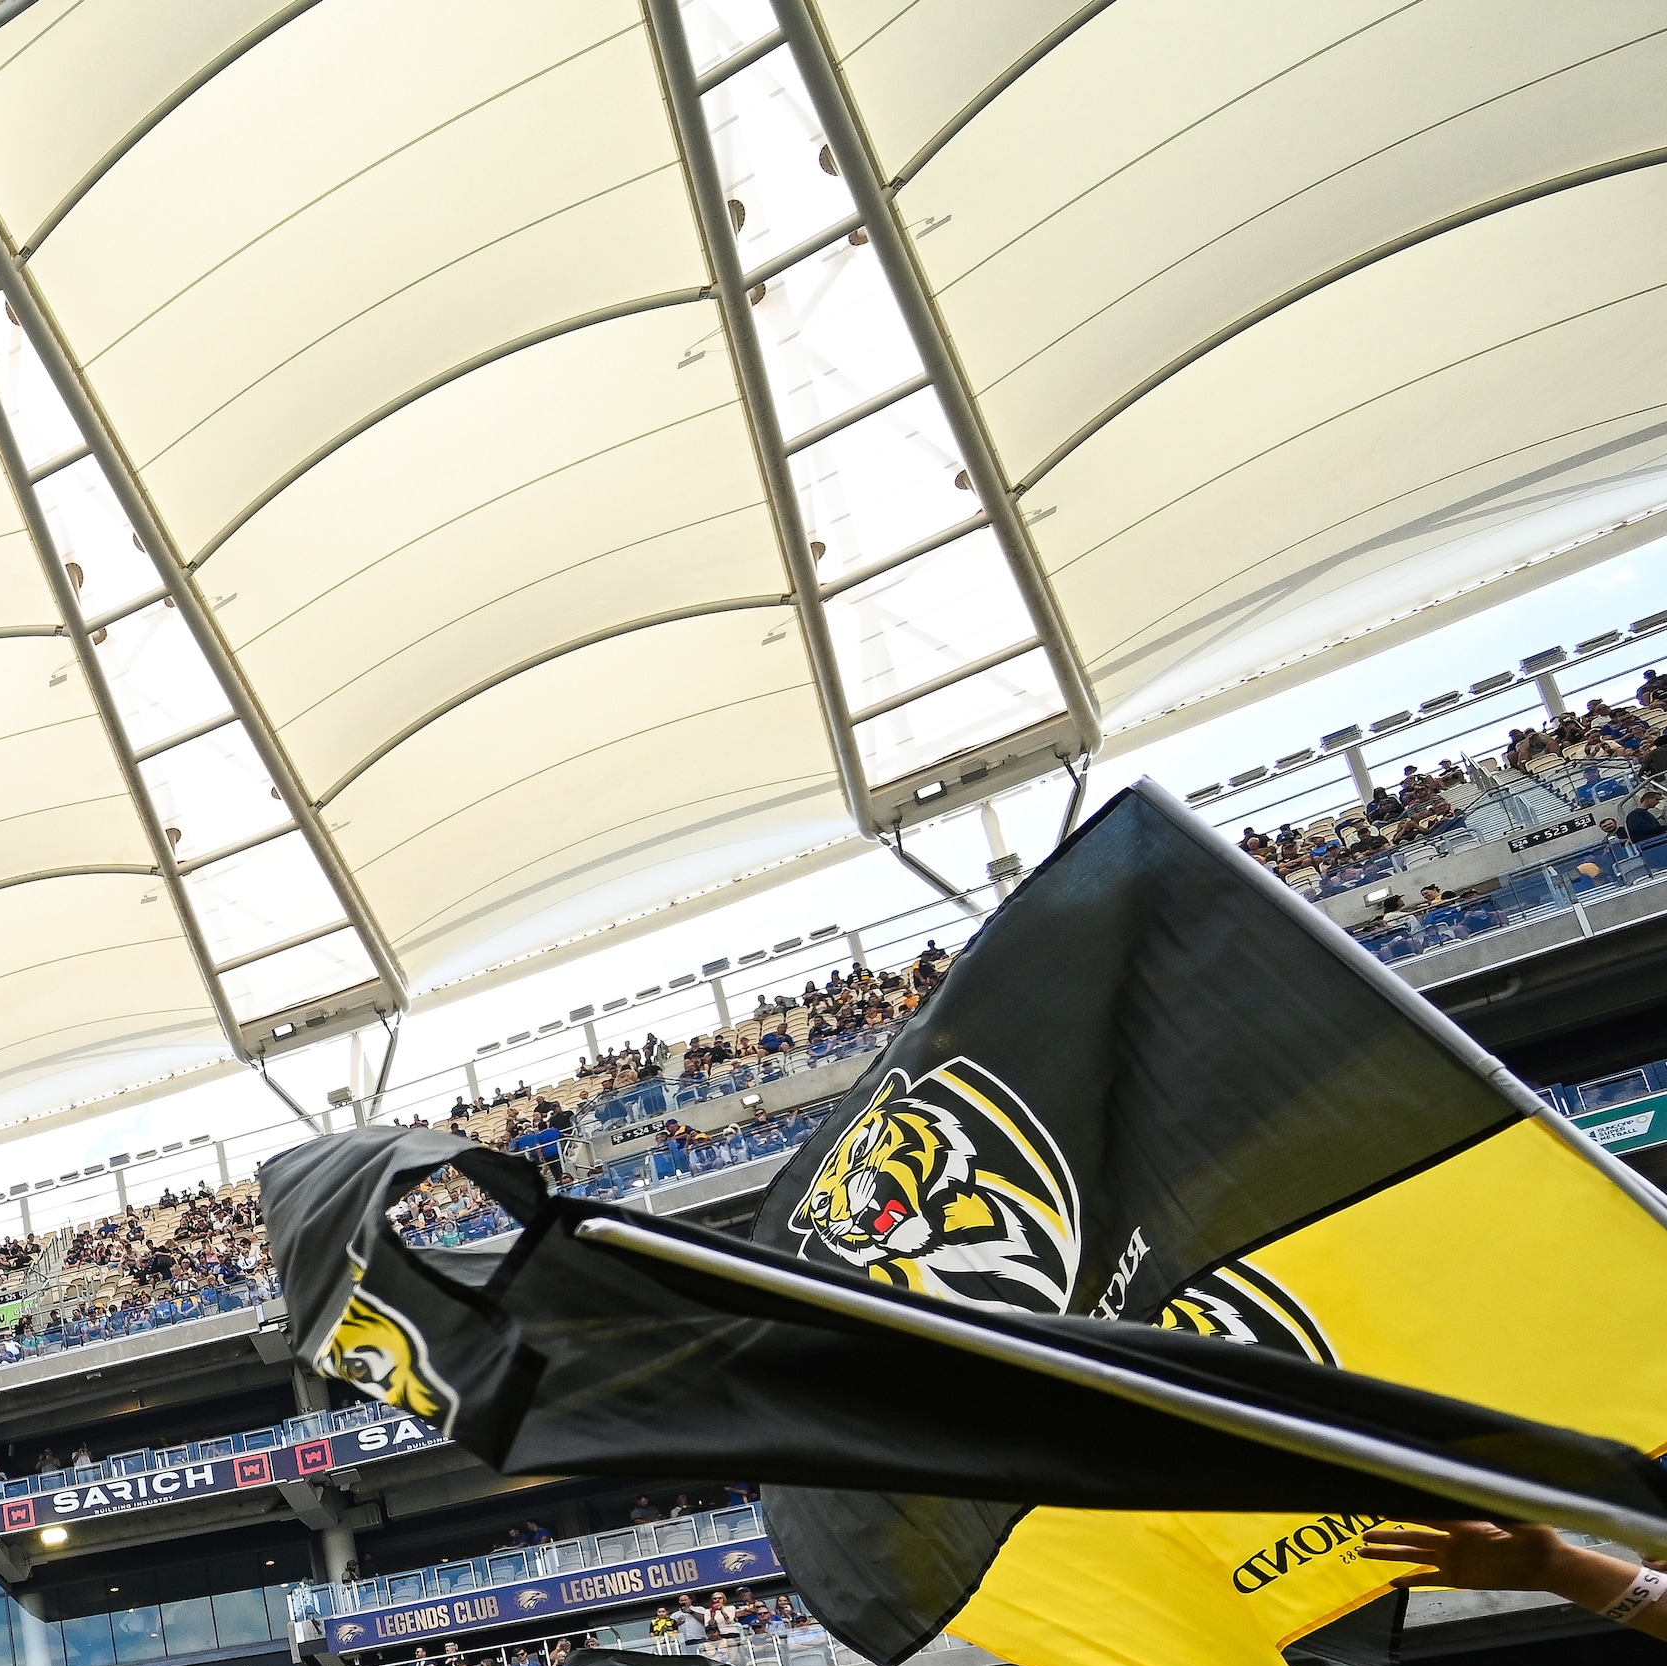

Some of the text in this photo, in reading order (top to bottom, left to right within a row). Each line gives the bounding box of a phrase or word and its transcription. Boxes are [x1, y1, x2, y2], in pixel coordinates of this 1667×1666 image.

[1544, 824, 1569, 839] 523
[53, 1464, 215, 1514] SARICH
[94, 1495, 175, 1516] BUILDING INDUSTRY
[561, 1558, 699, 1605] LEGENDS CLUB
[375, 1595, 500, 1639] LEGENDS CLUB
